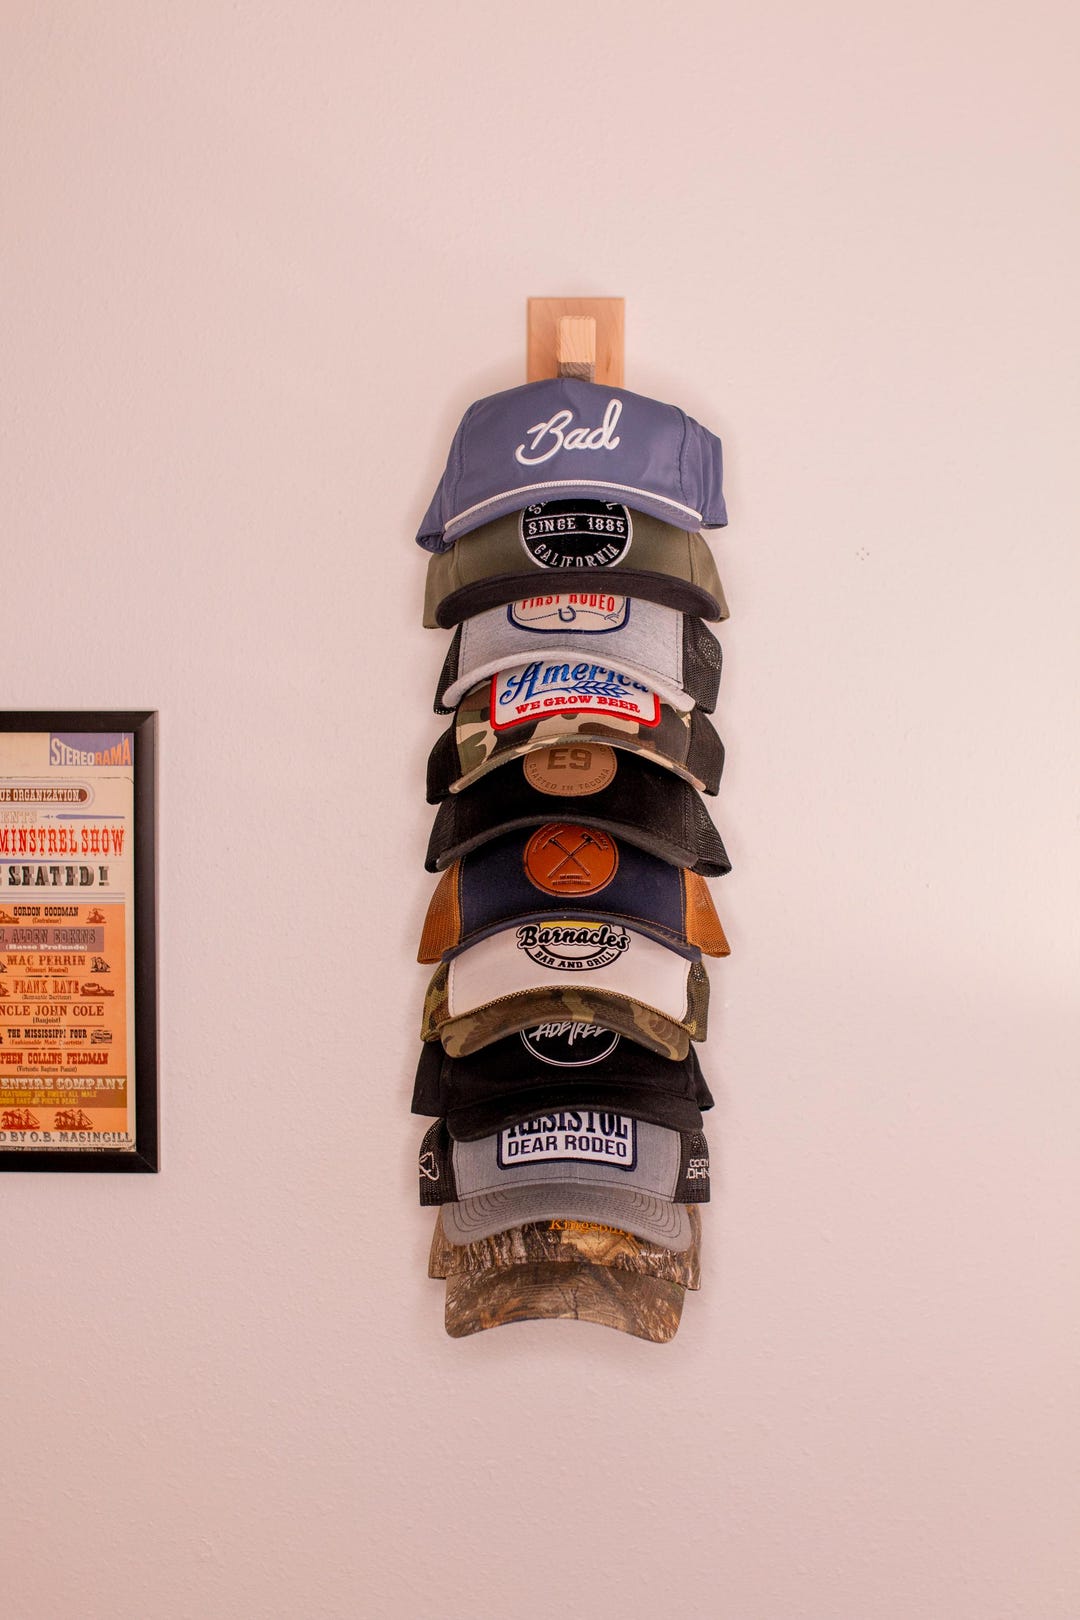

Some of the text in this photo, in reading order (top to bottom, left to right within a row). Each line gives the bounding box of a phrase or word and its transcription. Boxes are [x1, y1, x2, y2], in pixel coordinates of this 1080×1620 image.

[515, 399, 623, 466] Bad
[528, 517, 625, 535] SINCE 1885
[534, 543, 620, 568] CALIFORNIA
[515, 695, 641, 714] WE GROW BEER
[51, 737, 132, 765] STEREORAMA
[547, 748, 592, 770] E9
[529, 763, 558, 790] CRAFTED
[0, 827, 124, 855] MINSTREL SHOW
[13, 907, 79, 916] GORDON GOODMAN
[517, 924, 630, 951] Barnacles
[7, 955, 86, 966] MAC PERRIN
[534, 951, 554, 965] BAR
[587, 951, 615, 967] GRILL
[35, 1005, 67, 1016] JOHN
[73, 1006, 104, 1016] COLE
[8, 1029, 87, 1038] THE MISSISSIPPI FOUR
[28, 1053, 62, 1064] COLLINS
[67, 1053, 108, 1064] FELDMAN
[57, 1078, 126, 1090] COMPANY
[11, 1132, 26, 1142] BY
[60, 1132, 132, 1142] MASINGILL
[508, 1135, 627, 1158] DEAR RODEO
